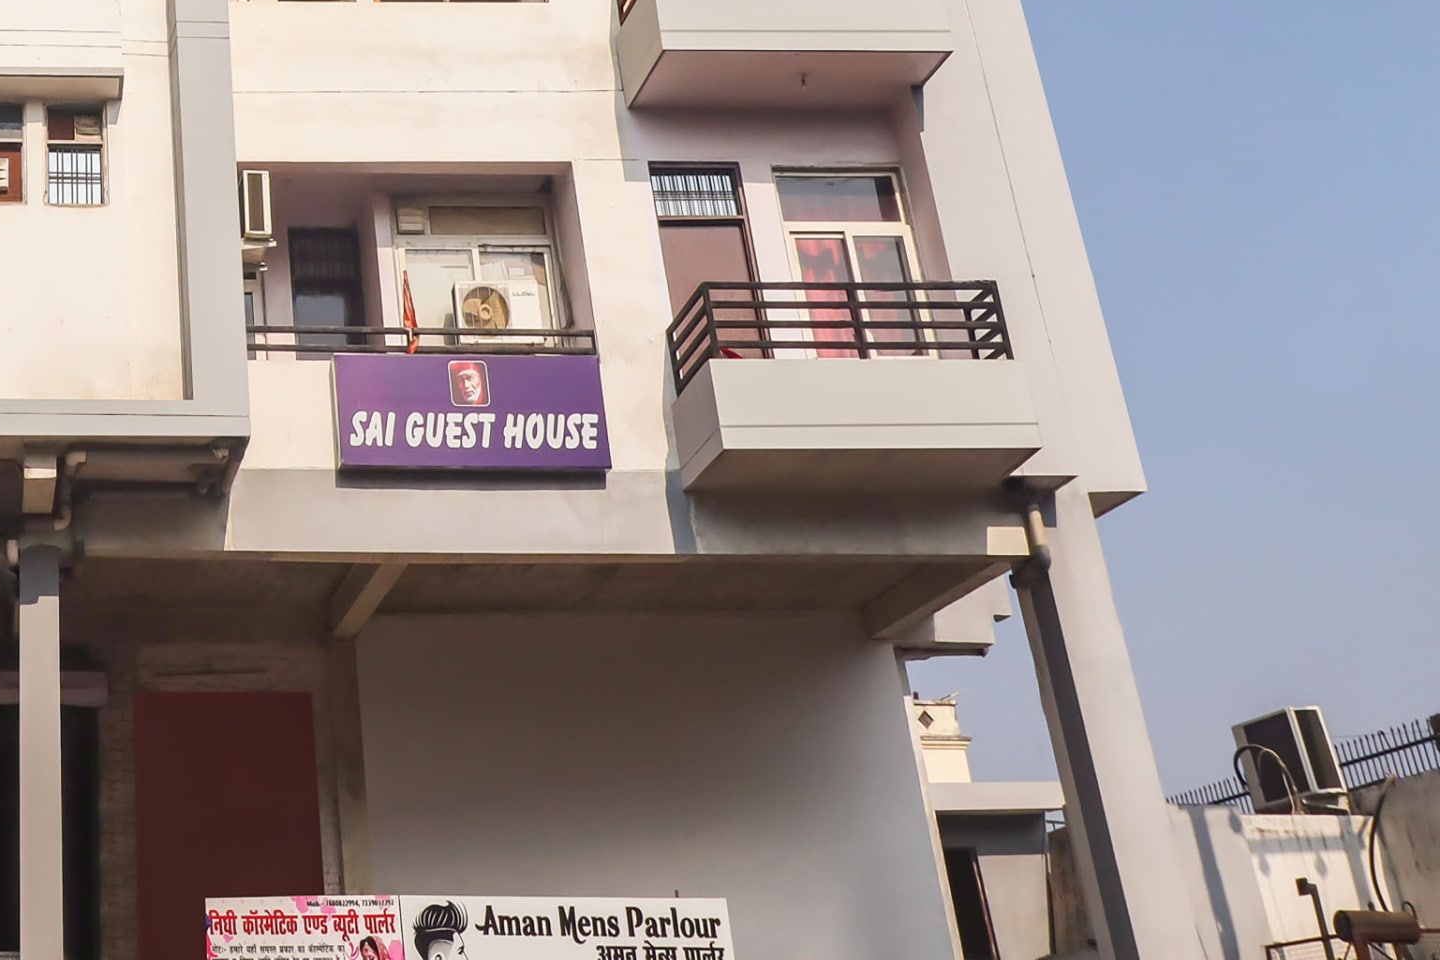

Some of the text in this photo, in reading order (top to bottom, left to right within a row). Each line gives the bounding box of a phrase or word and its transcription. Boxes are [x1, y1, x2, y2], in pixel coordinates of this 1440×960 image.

[349, 411, 599, 450] SAI GUEST HOUSE
[302, 915, 328, 934] एण्ड
[363, 908, 396, 934] पार्लर
[475, 905, 721, 944] Aman Mens Parlour
